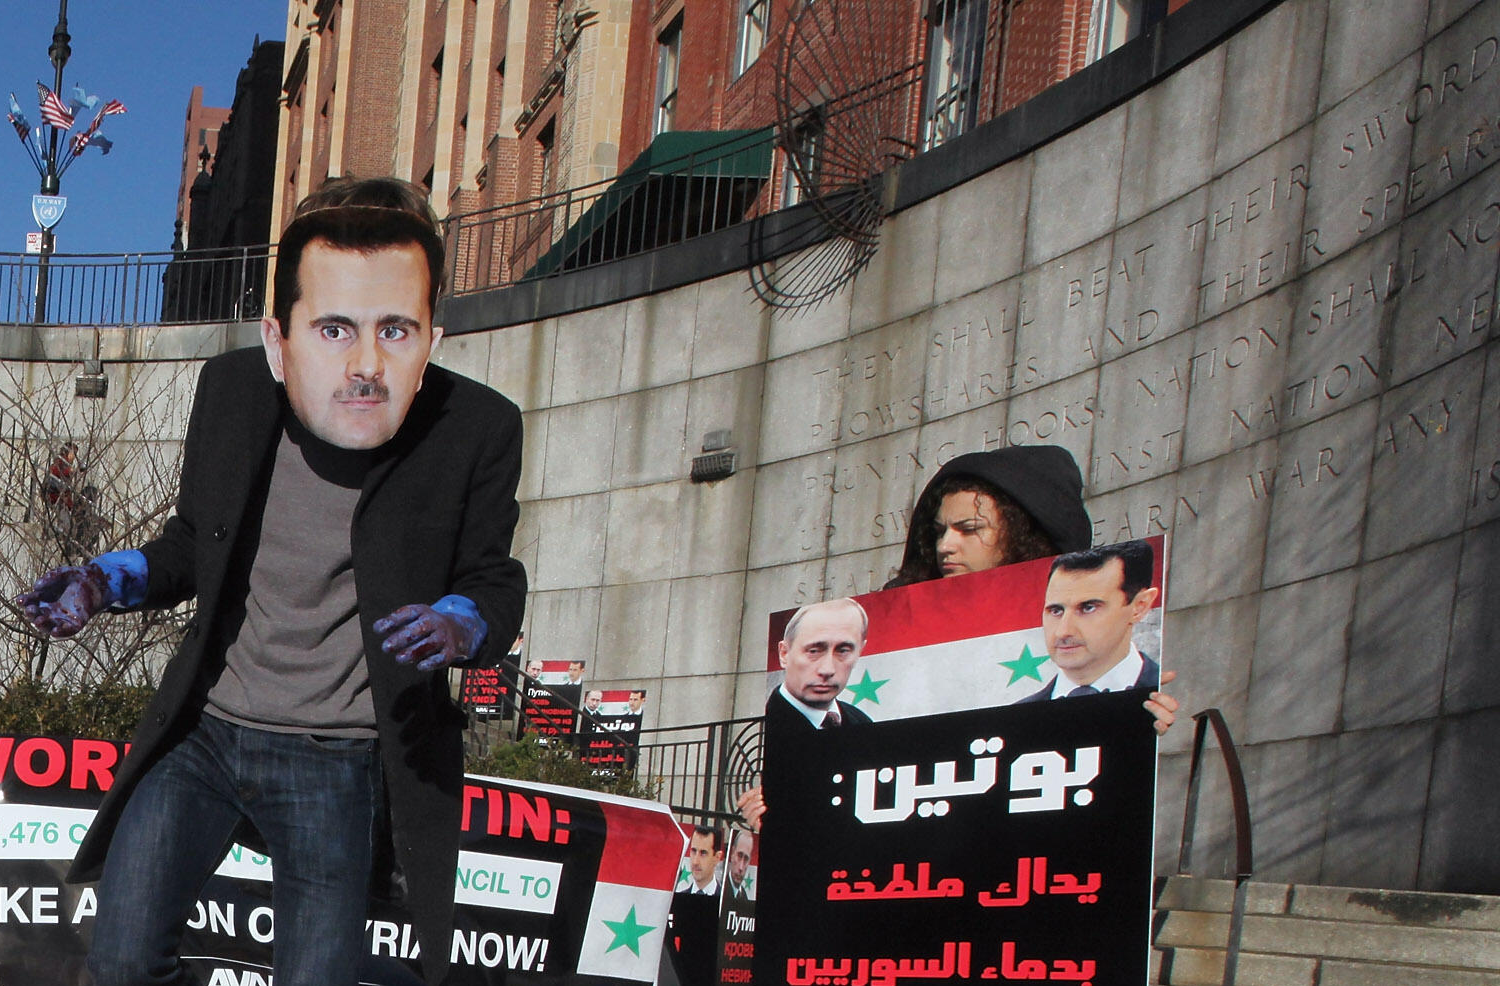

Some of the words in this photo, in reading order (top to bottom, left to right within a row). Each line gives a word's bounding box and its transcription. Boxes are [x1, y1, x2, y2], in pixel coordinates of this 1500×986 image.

[812, 346, 901, 394] THEY
[931, 299, 1035, 357] SHALL
[1067, 246, 1155, 308] BEAT
[1186, 164, 1310, 251] THEIR
[1083, 309, 1160, 360] AND
[1197, 229, 1325, 314] THEIR
[1356, 117, 1500, 234] SPEAR
[805, 441, 956, 495] PRUNING
[1133, 318, 1282, 407] NATION
[1306, 248, 1426, 336] SHALL
[871, 508, 911, 538] SW
[1092, 430, 1180, 484] INST
[1092, 490, 1202, 548] EARN
[1246, 446, 1341, 500] WAR
[1383, 390, 1463, 454] ANY
[460, 785, 572, 845] TIN:
[832, 737, 1102, 824] بوتين:
[454, 868, 511, 895] NCIL
[519, 875, 552, 899] TO
[826, 862, 964, 901] ملطخة
[978, 857, 1102, 907] يداك
[248, 907, 274, 944] O
[450, 929, 549, 972] NOW!
